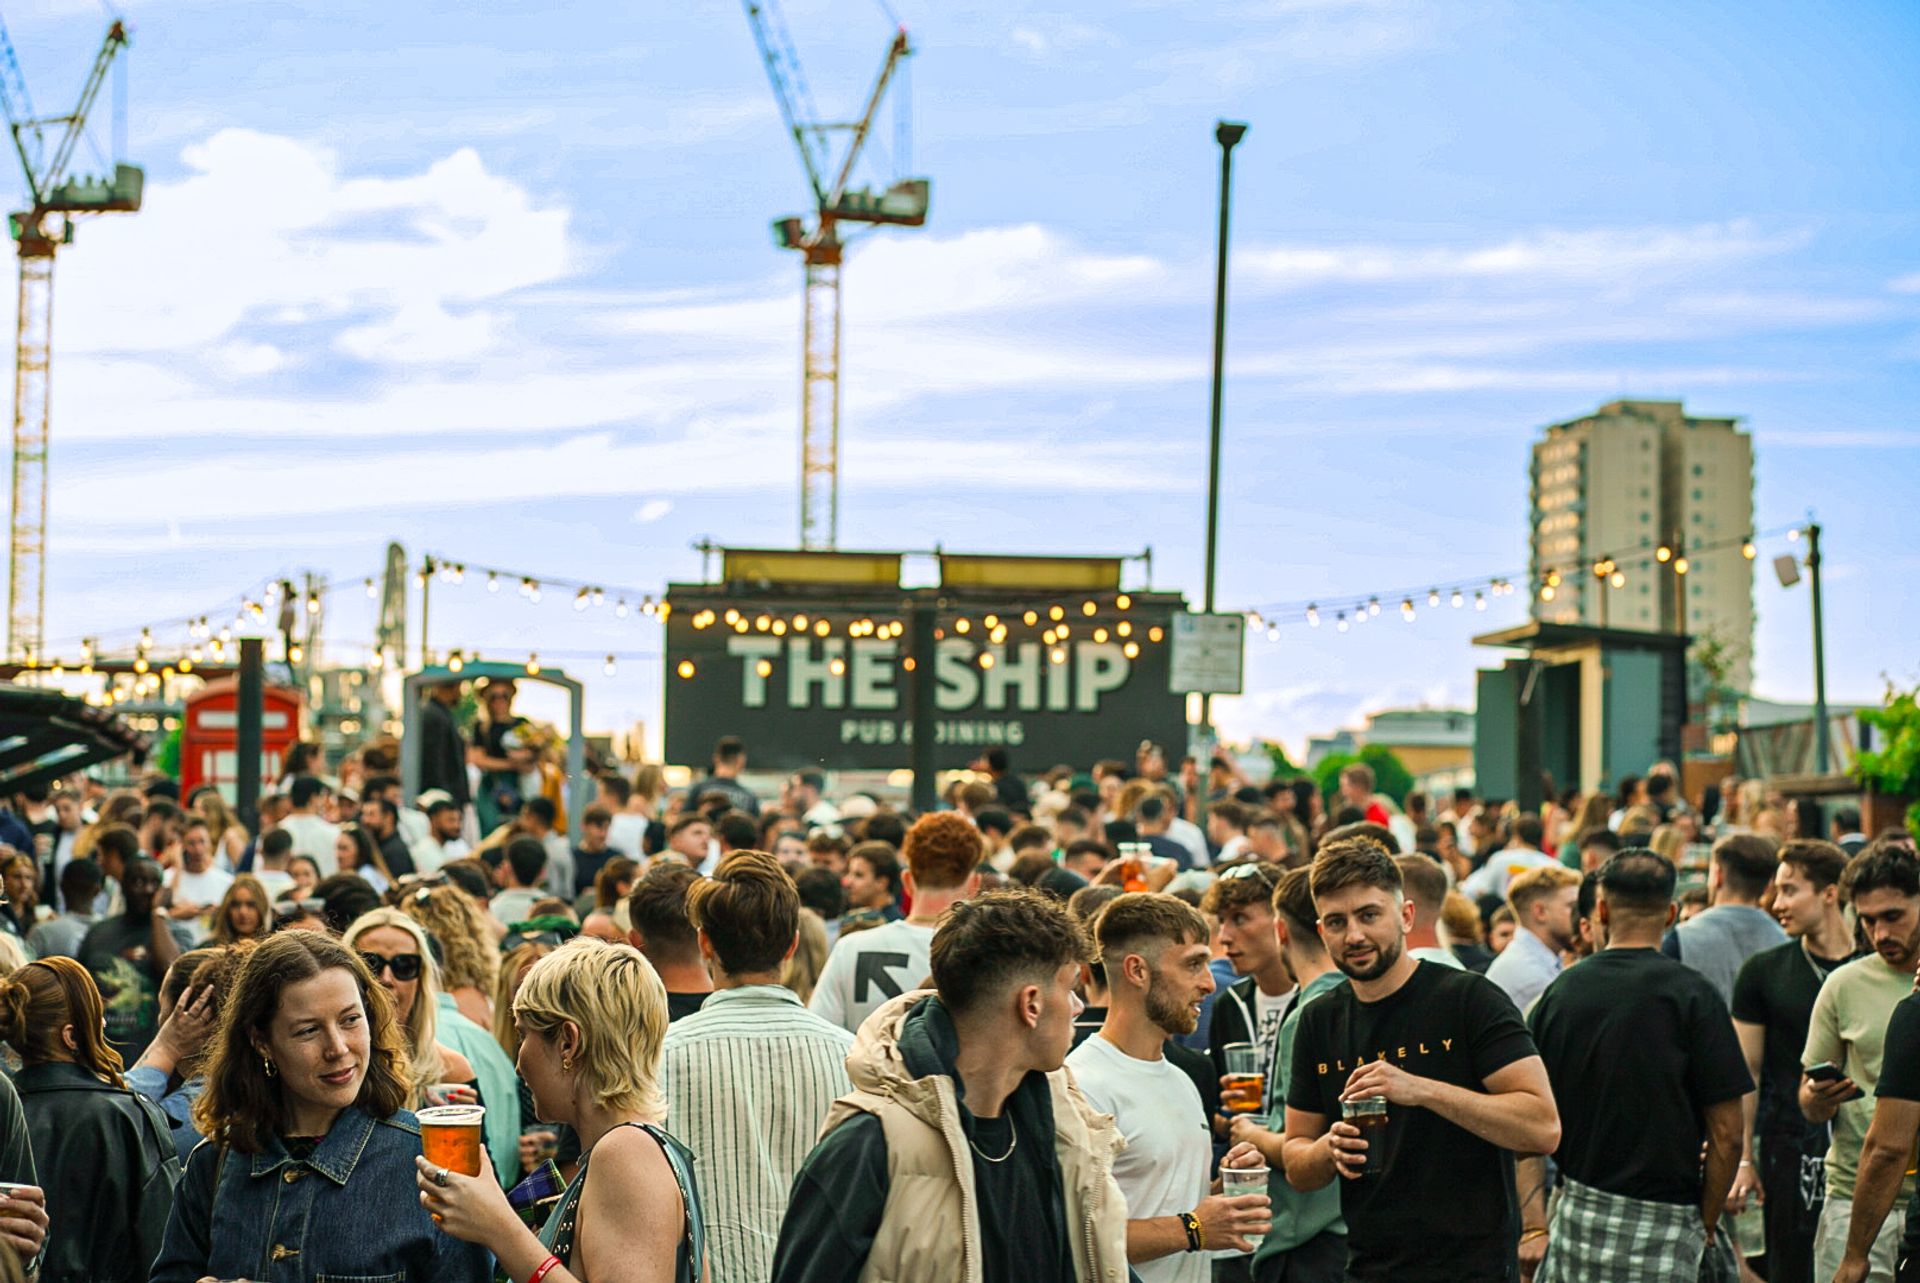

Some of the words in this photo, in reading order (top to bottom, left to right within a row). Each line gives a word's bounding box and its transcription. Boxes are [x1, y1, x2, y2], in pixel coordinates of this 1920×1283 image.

[727, 635, 898, 708] THE
[934, 638, 1130, 711] SHIP
[840, 719, 897, 744] PUB
[1318, 1038, 1453, 1074] BLAKELY
